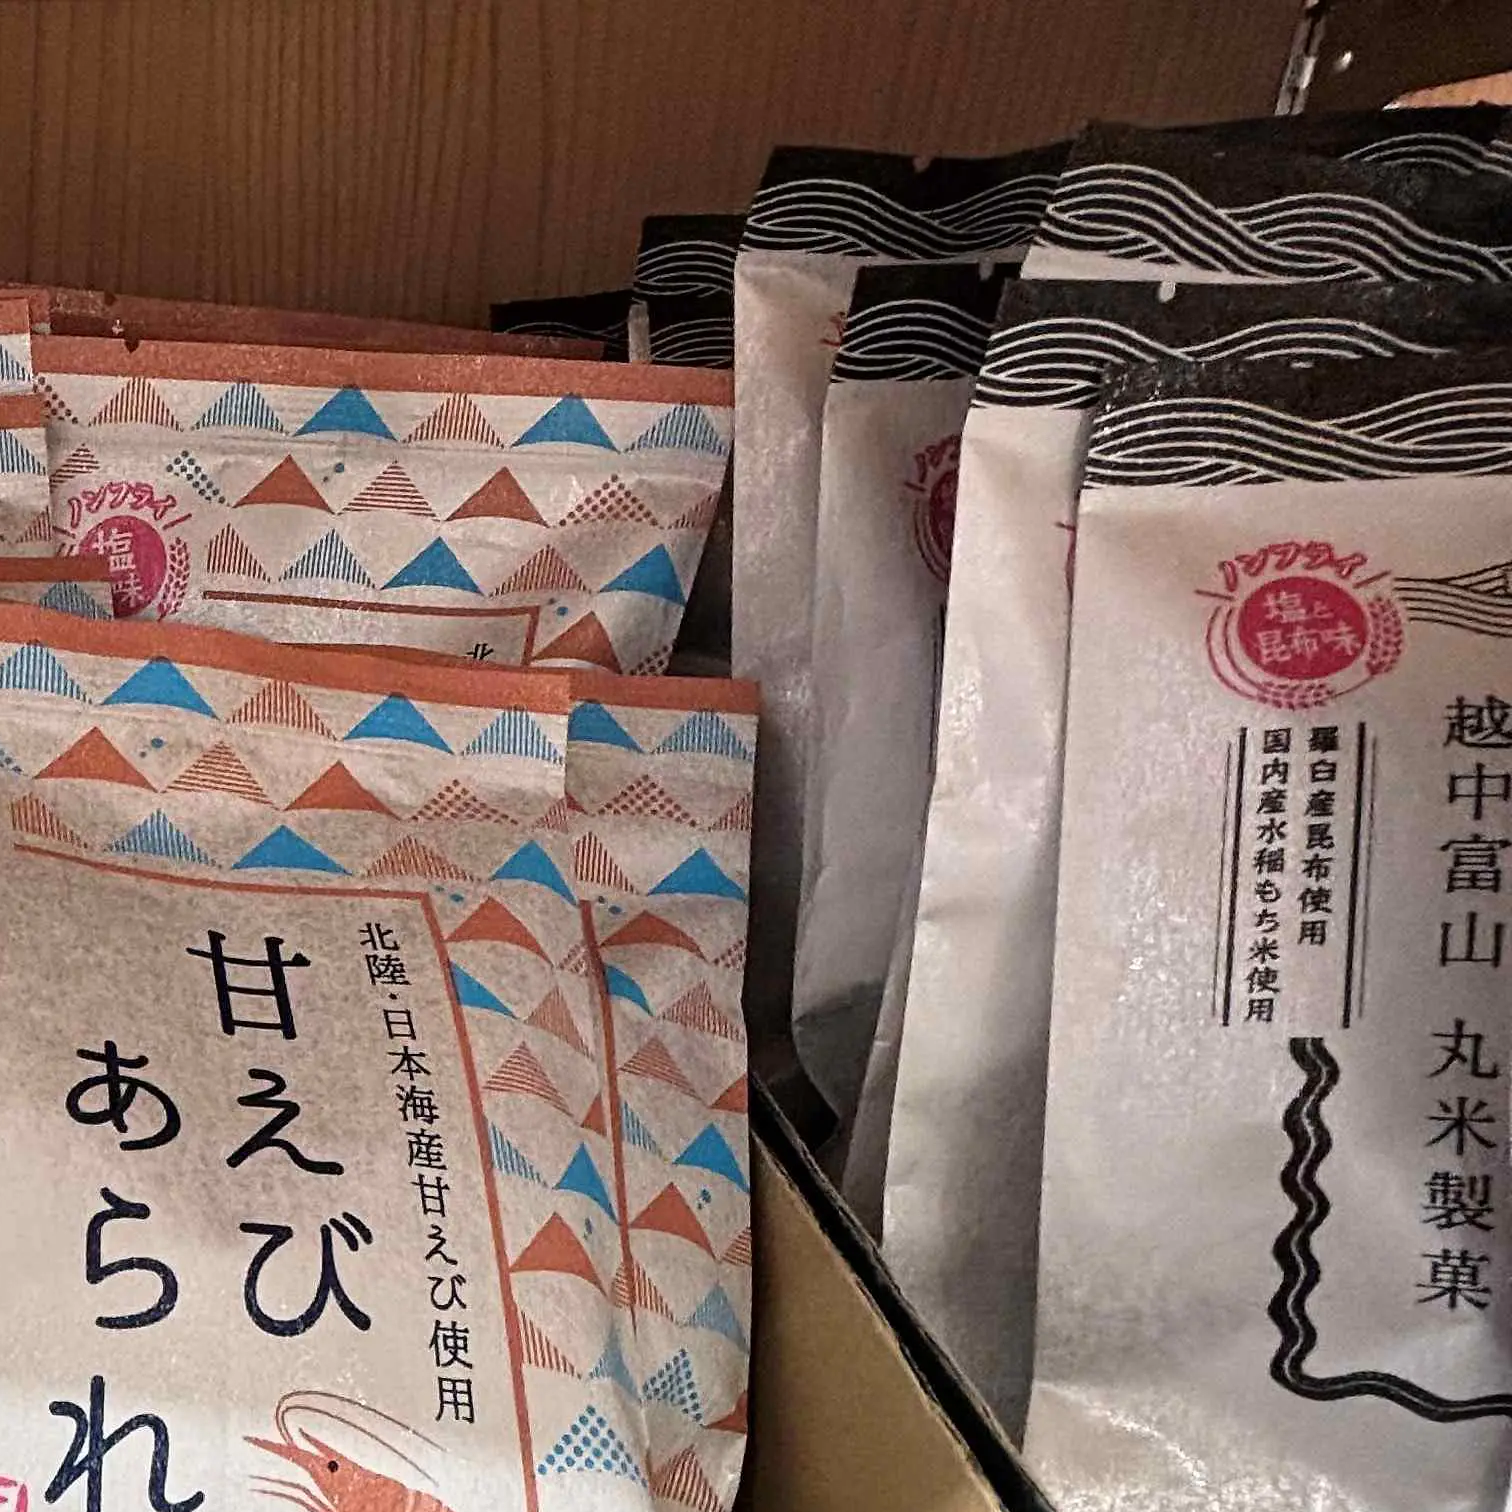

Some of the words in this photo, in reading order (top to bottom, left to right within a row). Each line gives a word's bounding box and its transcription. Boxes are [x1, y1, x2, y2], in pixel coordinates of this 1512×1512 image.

[68, 481, 176, 528] ノンフライ
[1218, 541, 1368, 592] ノンフライ
[1256, 621, 1362, 665] 昆布味
[1244, 727, 1291, 1023] 国内産水稲もち米使用
[1440, 693, 1512, 969] 越中富山
[186, 930, 373, 1338] 甘えび
[359, 921, 475, 1424] 北陸・日本海産甘えび使用
[1416, 1016, 1499, 1311] 丸米製菓
